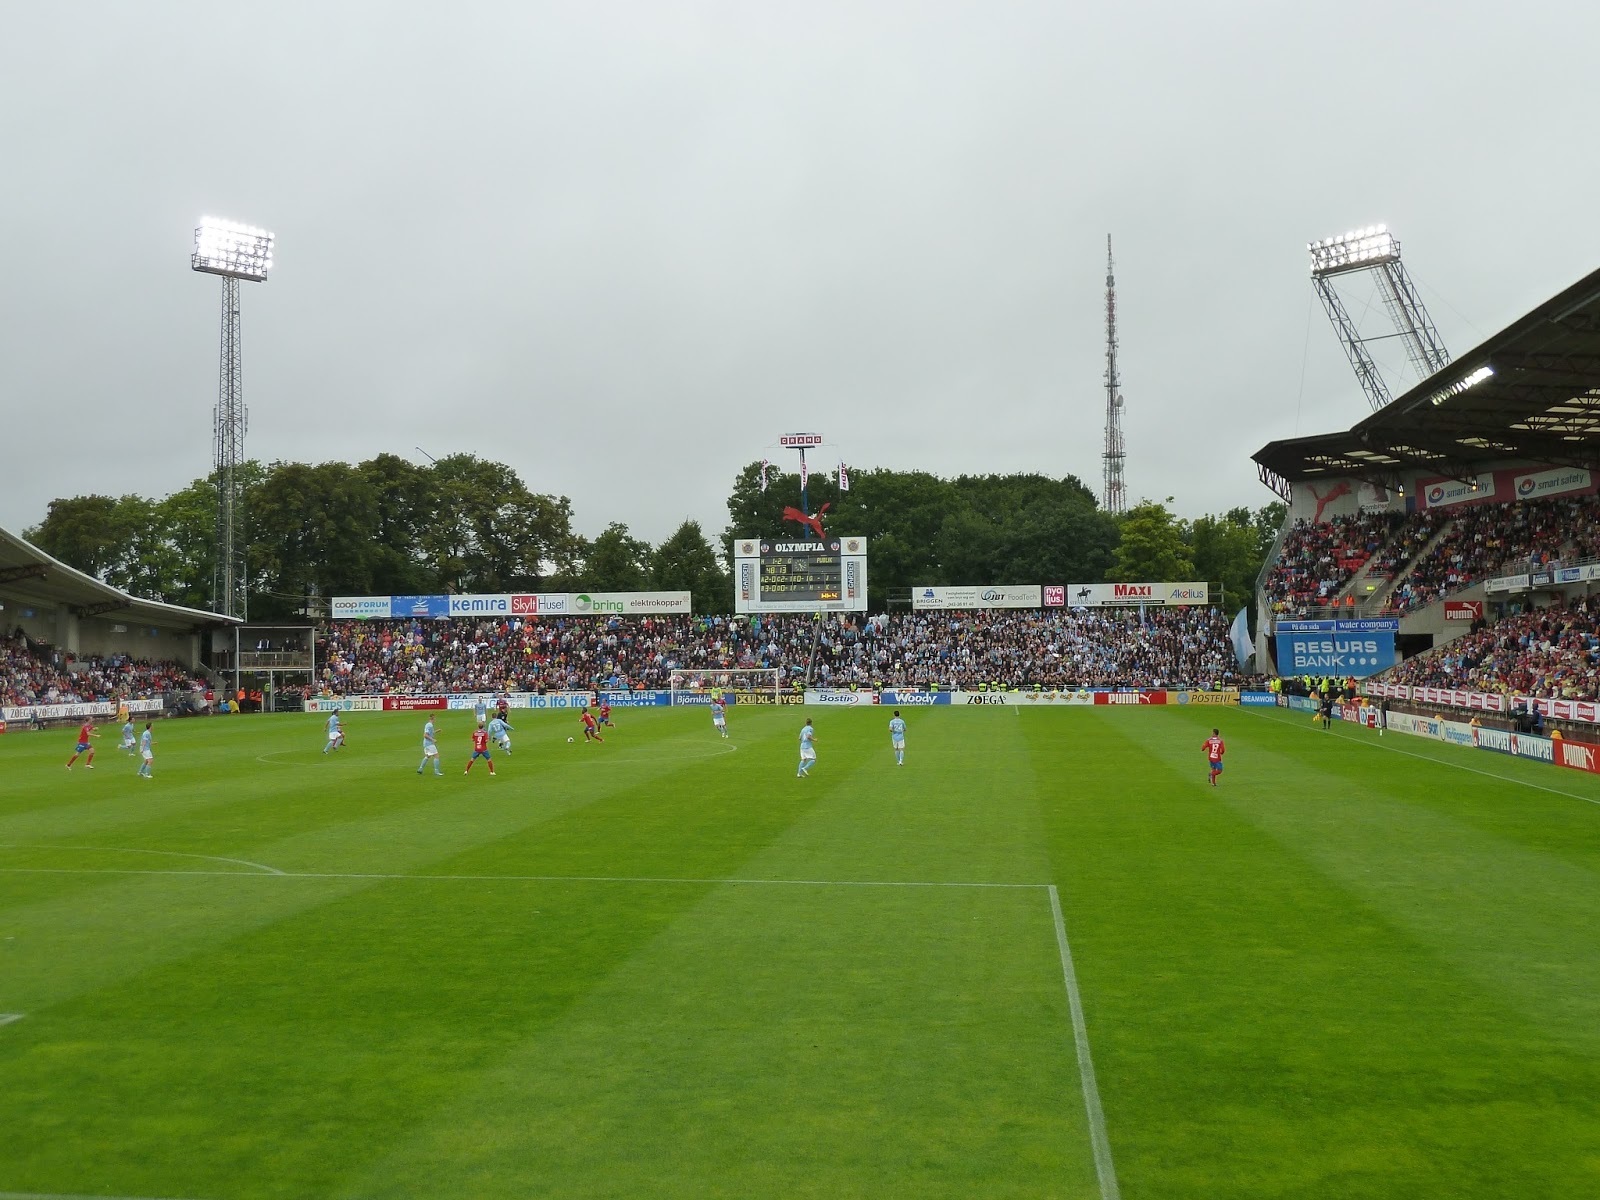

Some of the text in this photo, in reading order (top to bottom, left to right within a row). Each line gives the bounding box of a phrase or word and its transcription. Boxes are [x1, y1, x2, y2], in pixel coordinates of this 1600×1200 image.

[1537, 473, 1585, 490] smart safety
[1446, 482, 1489, 498] smart saety
[775, 542, 825, 552] OLYMPIA
[1046, 588, 1062, 596] nya
[1170, 589, 1204, 598] Akelius
[592, 599, 624, 612] bring
[630, 599, 683, 608] elektrokoppar
[1446, 610, 1473, 619] PUMA
[1360, 620, 1394, 630] company
[1294, 641, 1377, 653] RESURS
[1295, 656, 1345, 667] BANK
[677, 694, 726, 705] Björnklä
[819, 694, 853, 702] Bostik
[895, 693, 937, 705] Woody
[1108, 694, 1139, 704] PUMA
[319, 701, 378, 710] TIPS ELIT
[1562, 743, 1587, 769] PUMA
